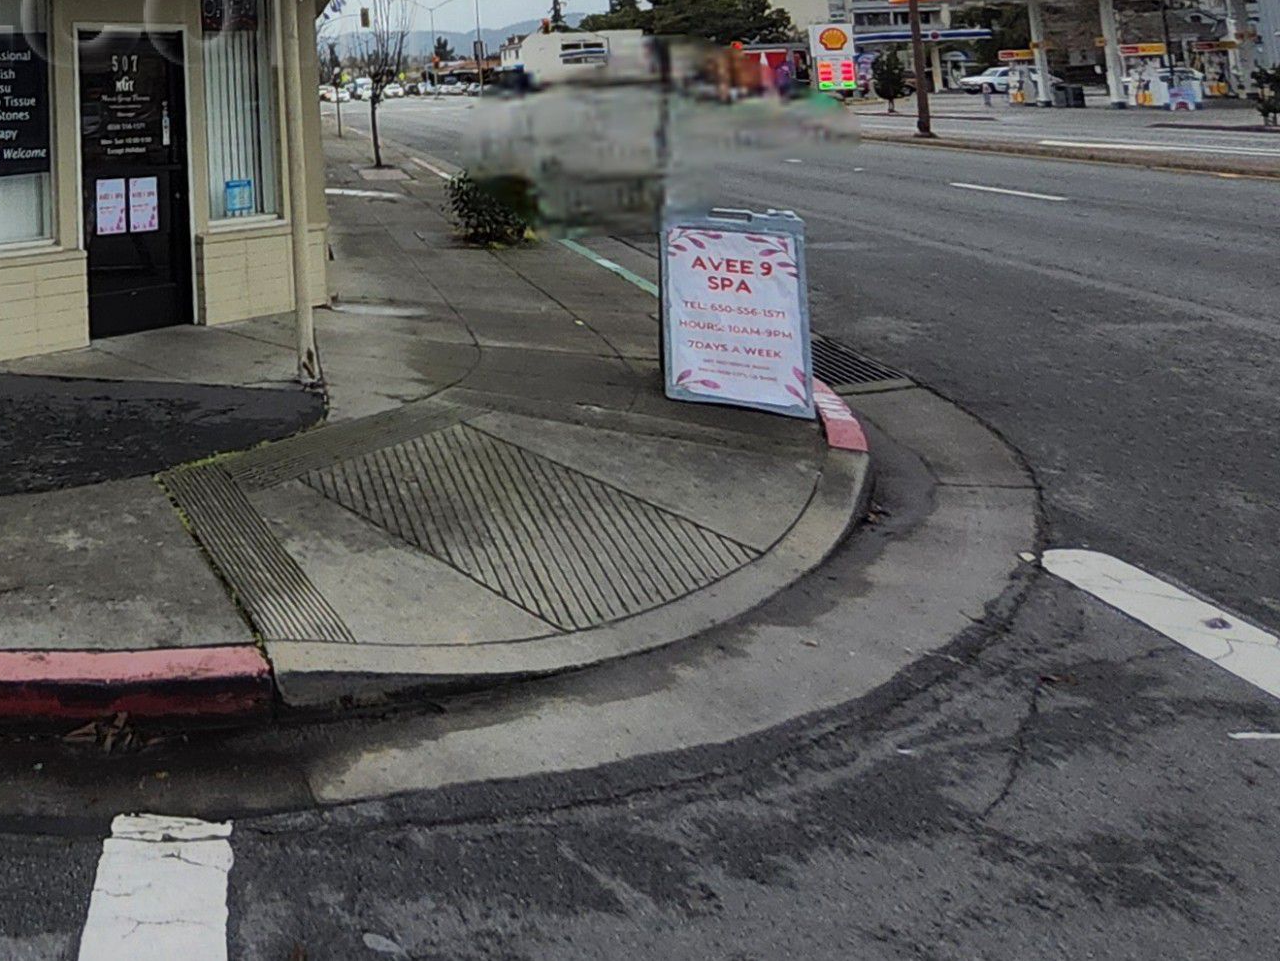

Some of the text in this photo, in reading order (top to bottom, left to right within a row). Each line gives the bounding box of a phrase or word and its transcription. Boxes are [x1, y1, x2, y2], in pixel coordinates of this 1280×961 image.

[111, 54, 138, 72] 507
[3, 96, 36, 107] Tissue
[3, 147, 47, 159] Welcome
[691, 256, 773, 277] AVEE 9
[707, 276, 752, 294] SPA
[727, 324, 793, 339] 10AM-9PM
[686, 339, 782, 359] 7DAYS A WEEK
